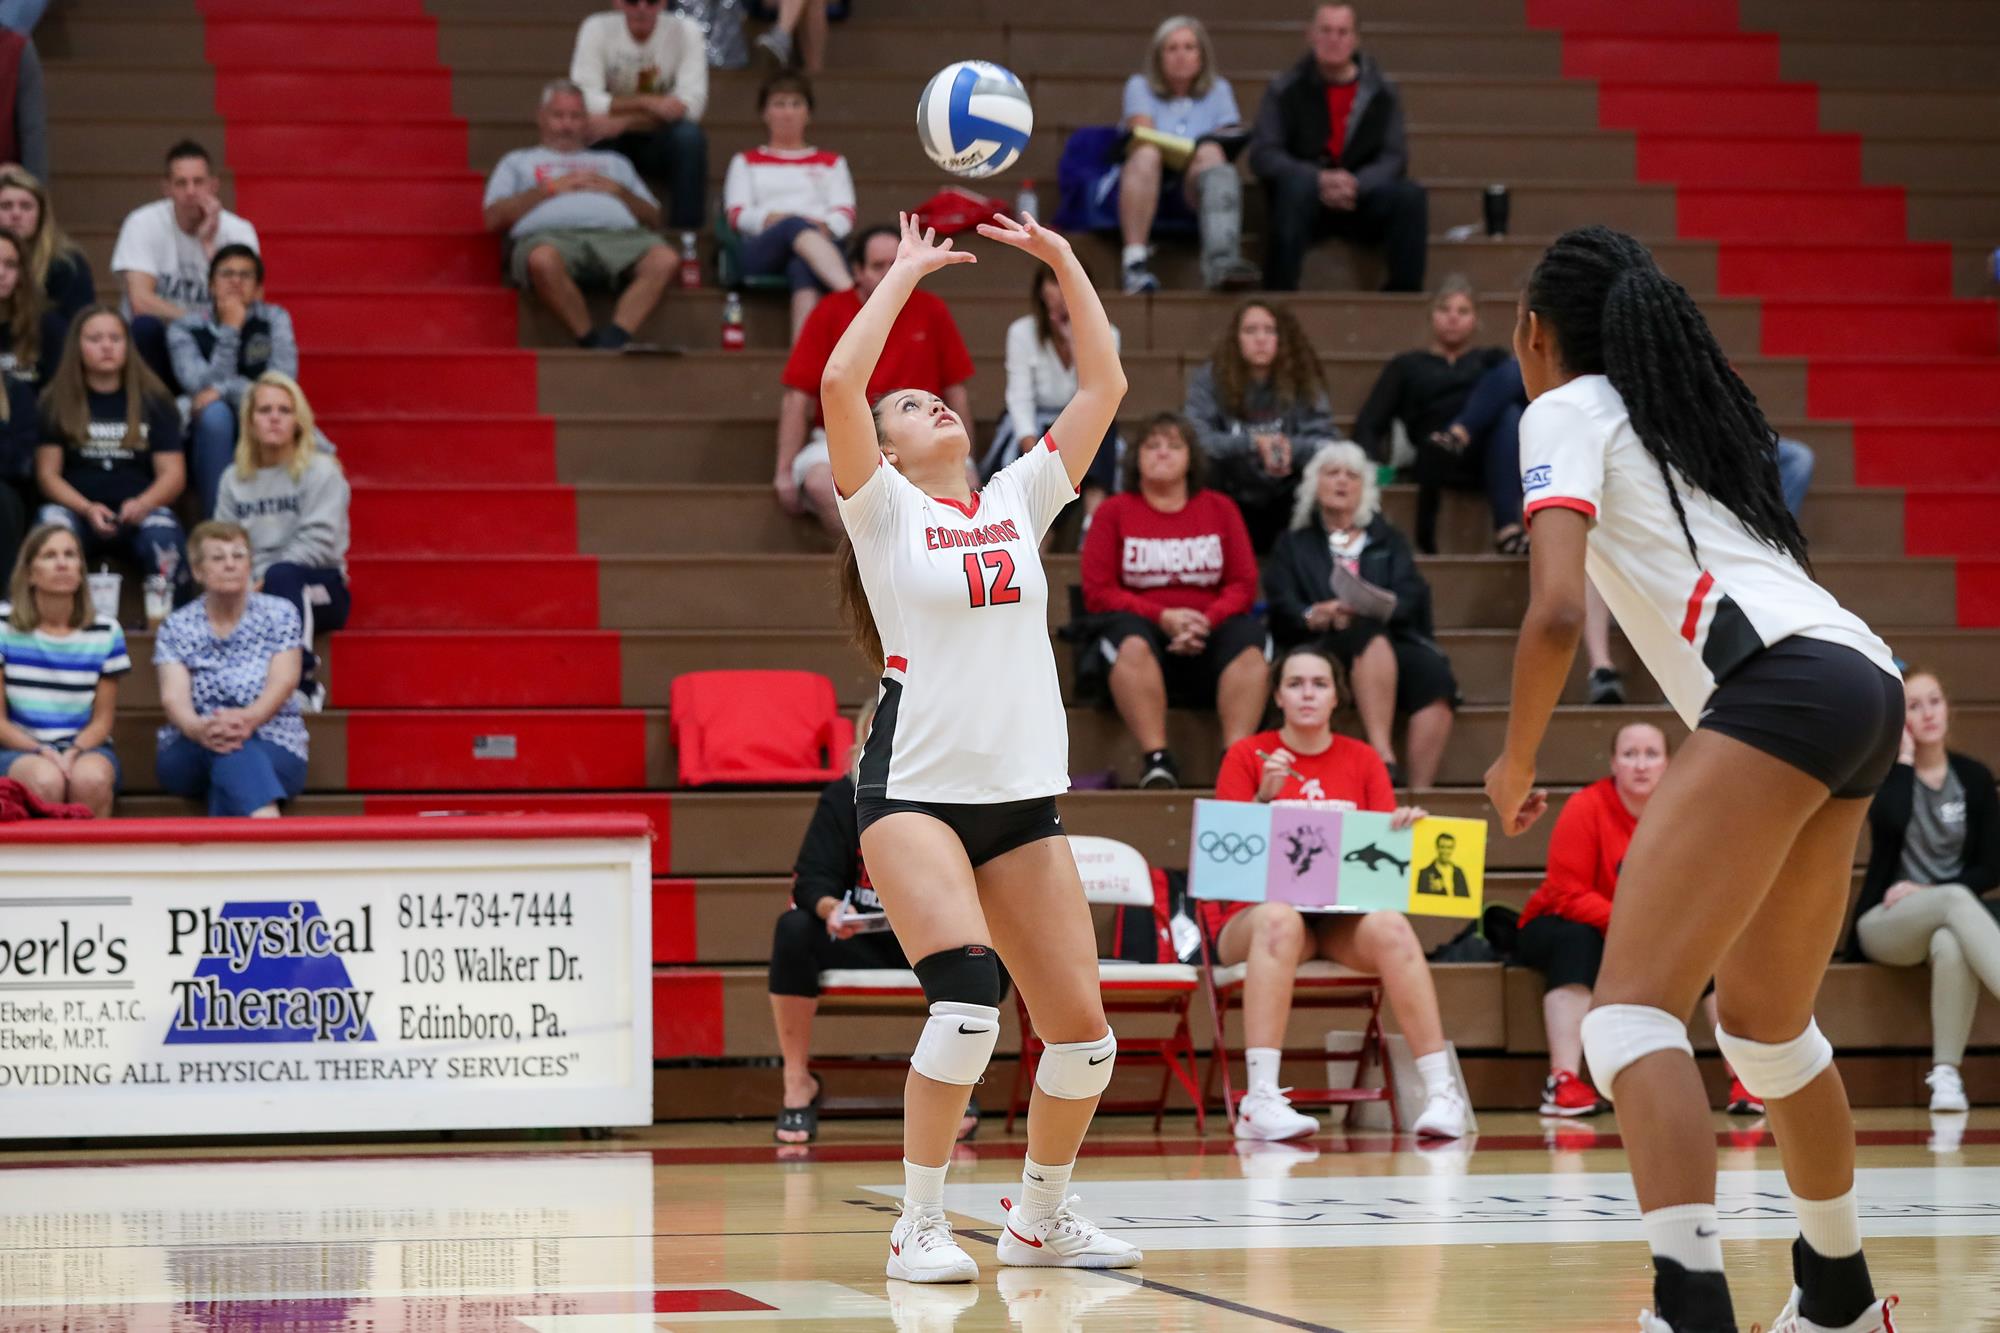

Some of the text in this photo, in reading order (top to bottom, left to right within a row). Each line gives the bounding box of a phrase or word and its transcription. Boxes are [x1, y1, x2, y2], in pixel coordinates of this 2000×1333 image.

[1122, 533, 1223, 573] EDINBORO
[963, 549, 1021, 608] 12
[398, 892, 573, 929] 814-734-7444
[167, 904, 375, 970] Physical
[402, 947, 582, 983] 103 Walker Dr.
[1, 1002, 58, 1026] Eberle,
[99, 1000, 146, 1022] A.T.C.
[170, 978, 374, 1040] Therapy
[400, 1003, 567, 1043] Edinboro, Pa.
[1, 1027, 109, 1052] Eberle, M.P.T.
[121, 1062, 170, 1085] ALL
[179, 1060, 309, 1083] PHYSICAL
[315, 1059, 437, 1081] THERAPY
[447, 1052, 580, 1078] SERVICES"
